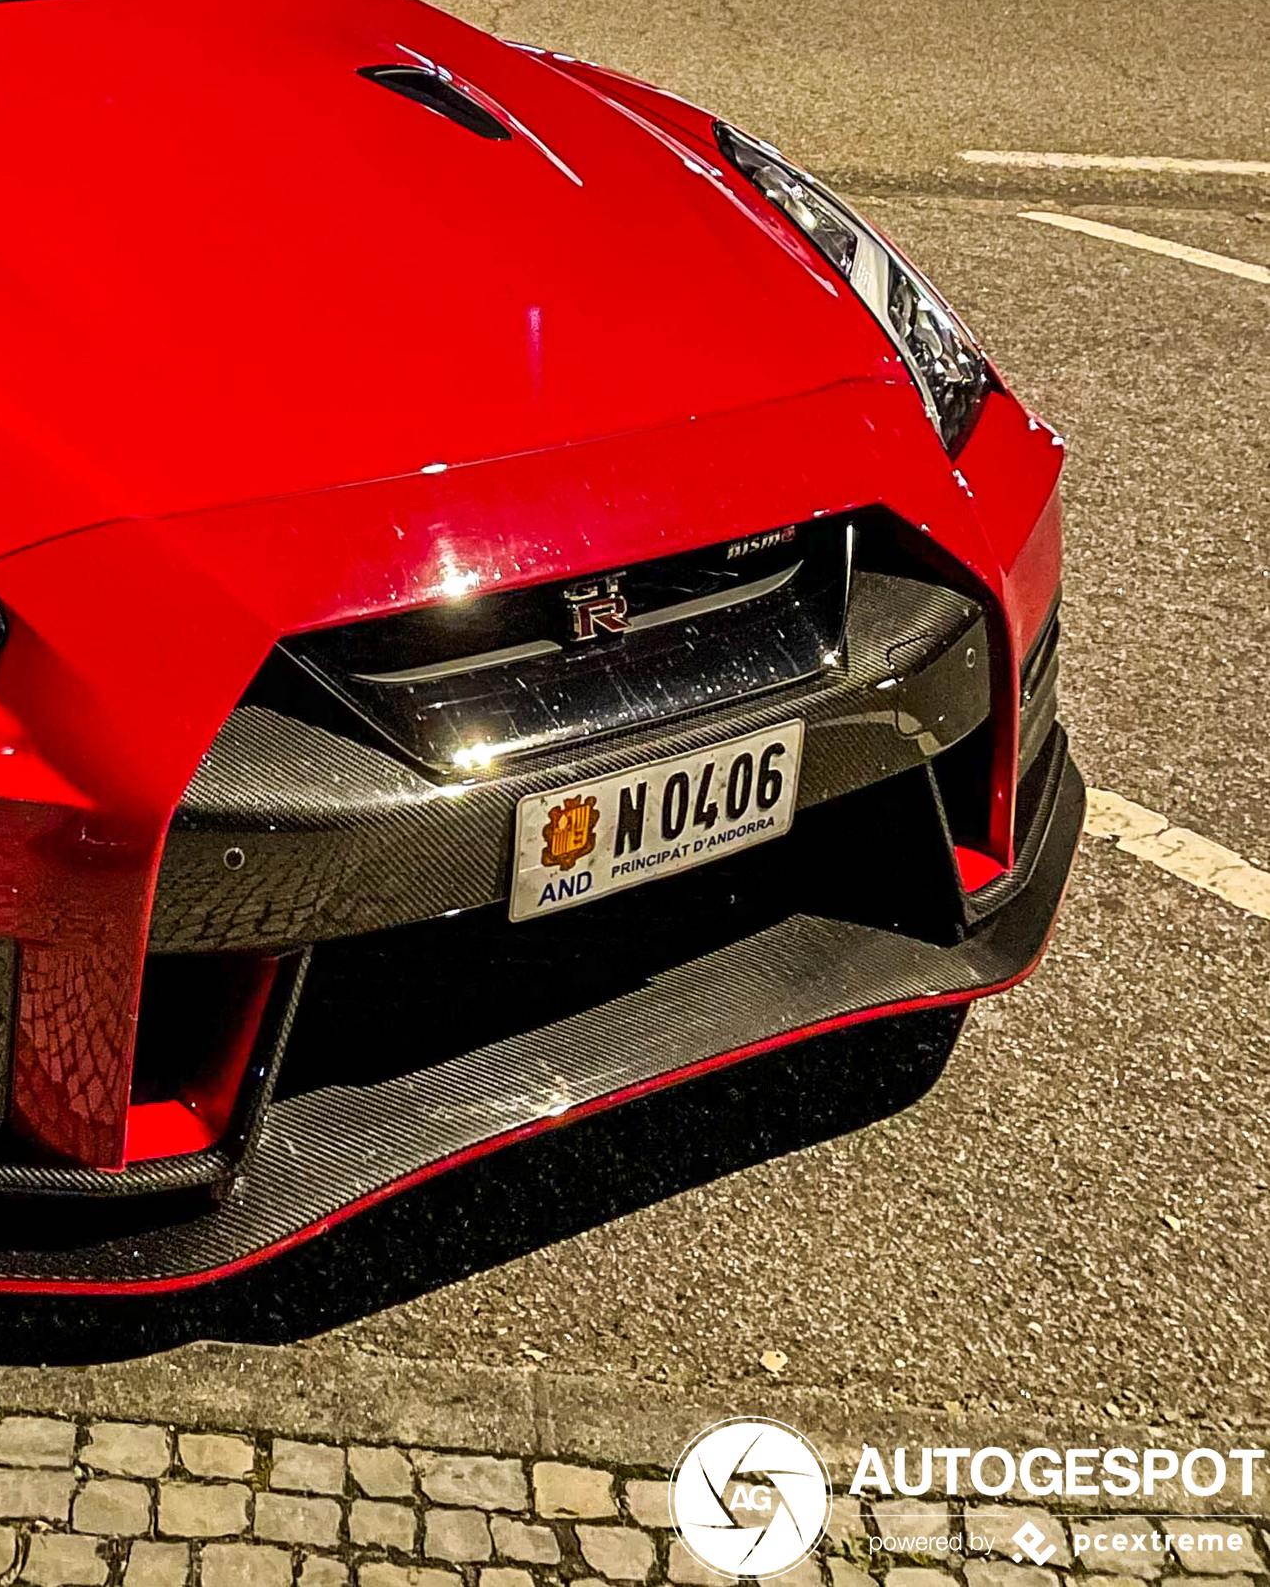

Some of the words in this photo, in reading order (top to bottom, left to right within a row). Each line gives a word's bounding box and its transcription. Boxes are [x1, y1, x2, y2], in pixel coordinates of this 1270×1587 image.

[571, 593, 632, 641] R
[614, 782, 647, 858] N
[661, 742, 786, 841] 0406
[611, 845, 689, 878] PRINCIPAT
[693, 816, 775, 853] D'ANDORRA
[538, 871, 592, 907] AND
